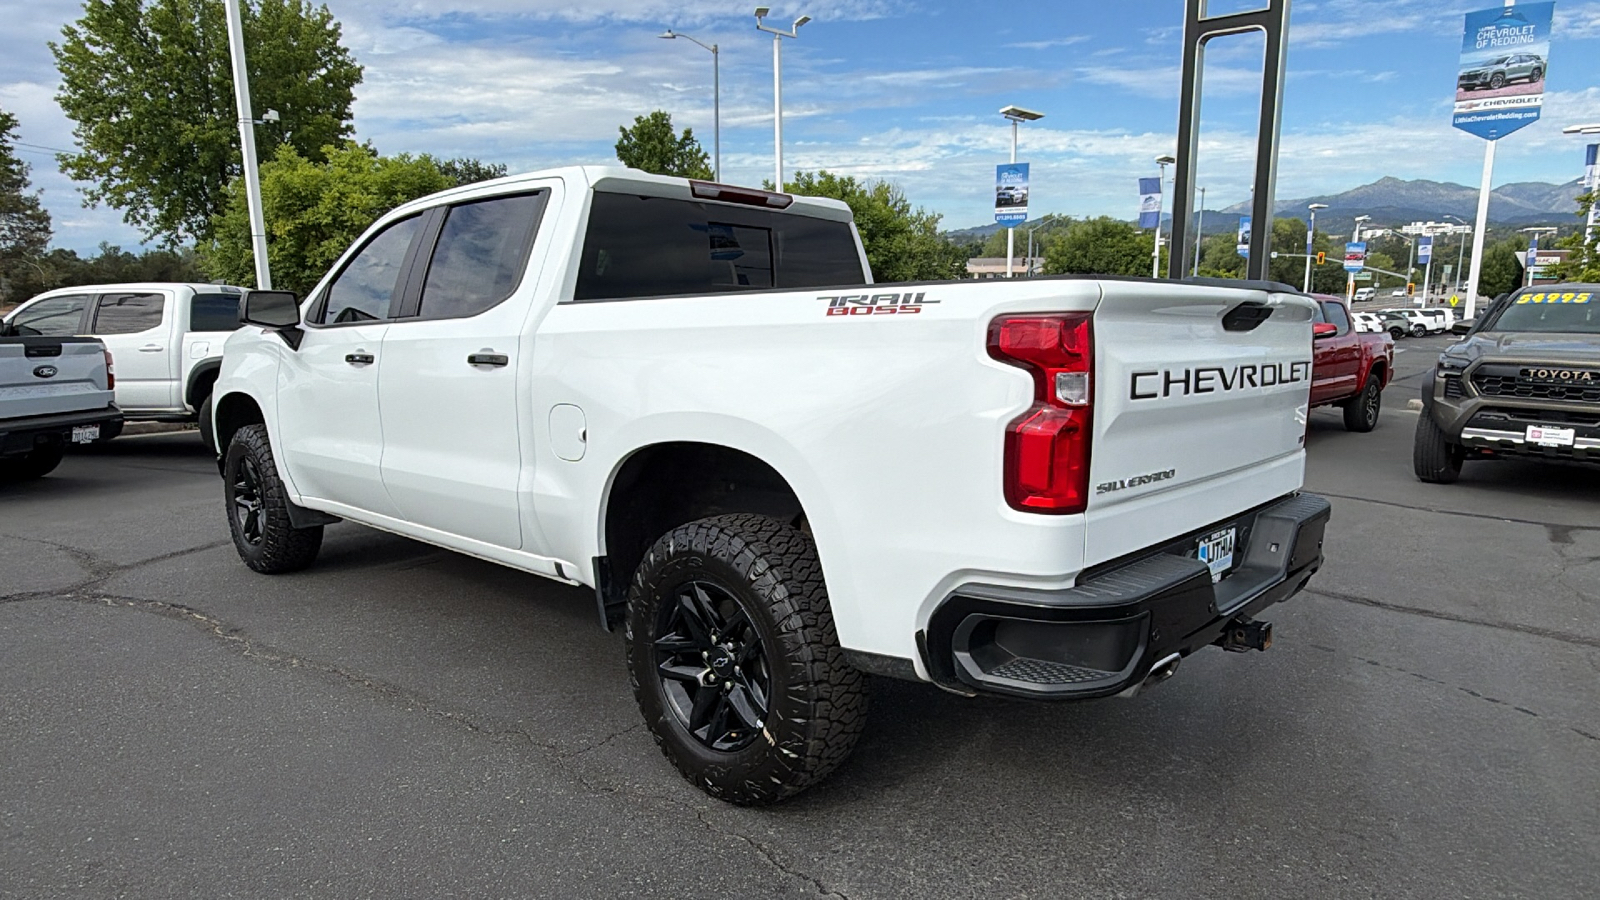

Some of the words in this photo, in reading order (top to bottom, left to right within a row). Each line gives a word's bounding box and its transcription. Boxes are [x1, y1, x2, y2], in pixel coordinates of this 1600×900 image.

[1476, 24, 1536, 41] CHEVROLET
[1475, 39, 1489, 49] OF
[1490, 34, 1534, 48] REDDING
[1483, 97, 1538, 106] CHEVROLET
[1455, 112, 1537, 123] LithiaChevroletRedding.com
[816, 292, 941, 307] TRAIL
[1516, 292, 1593, 304] 54995
[826, 304, 922, 316] BOSS
[1130, 361, 1312, 400] CHEVROLET
[1528, 369, 1591, 380] TOYOTA
[1096, 468, 1176, 495] SILVERADO
[1206, 534, 1233, 563] LITHIA
